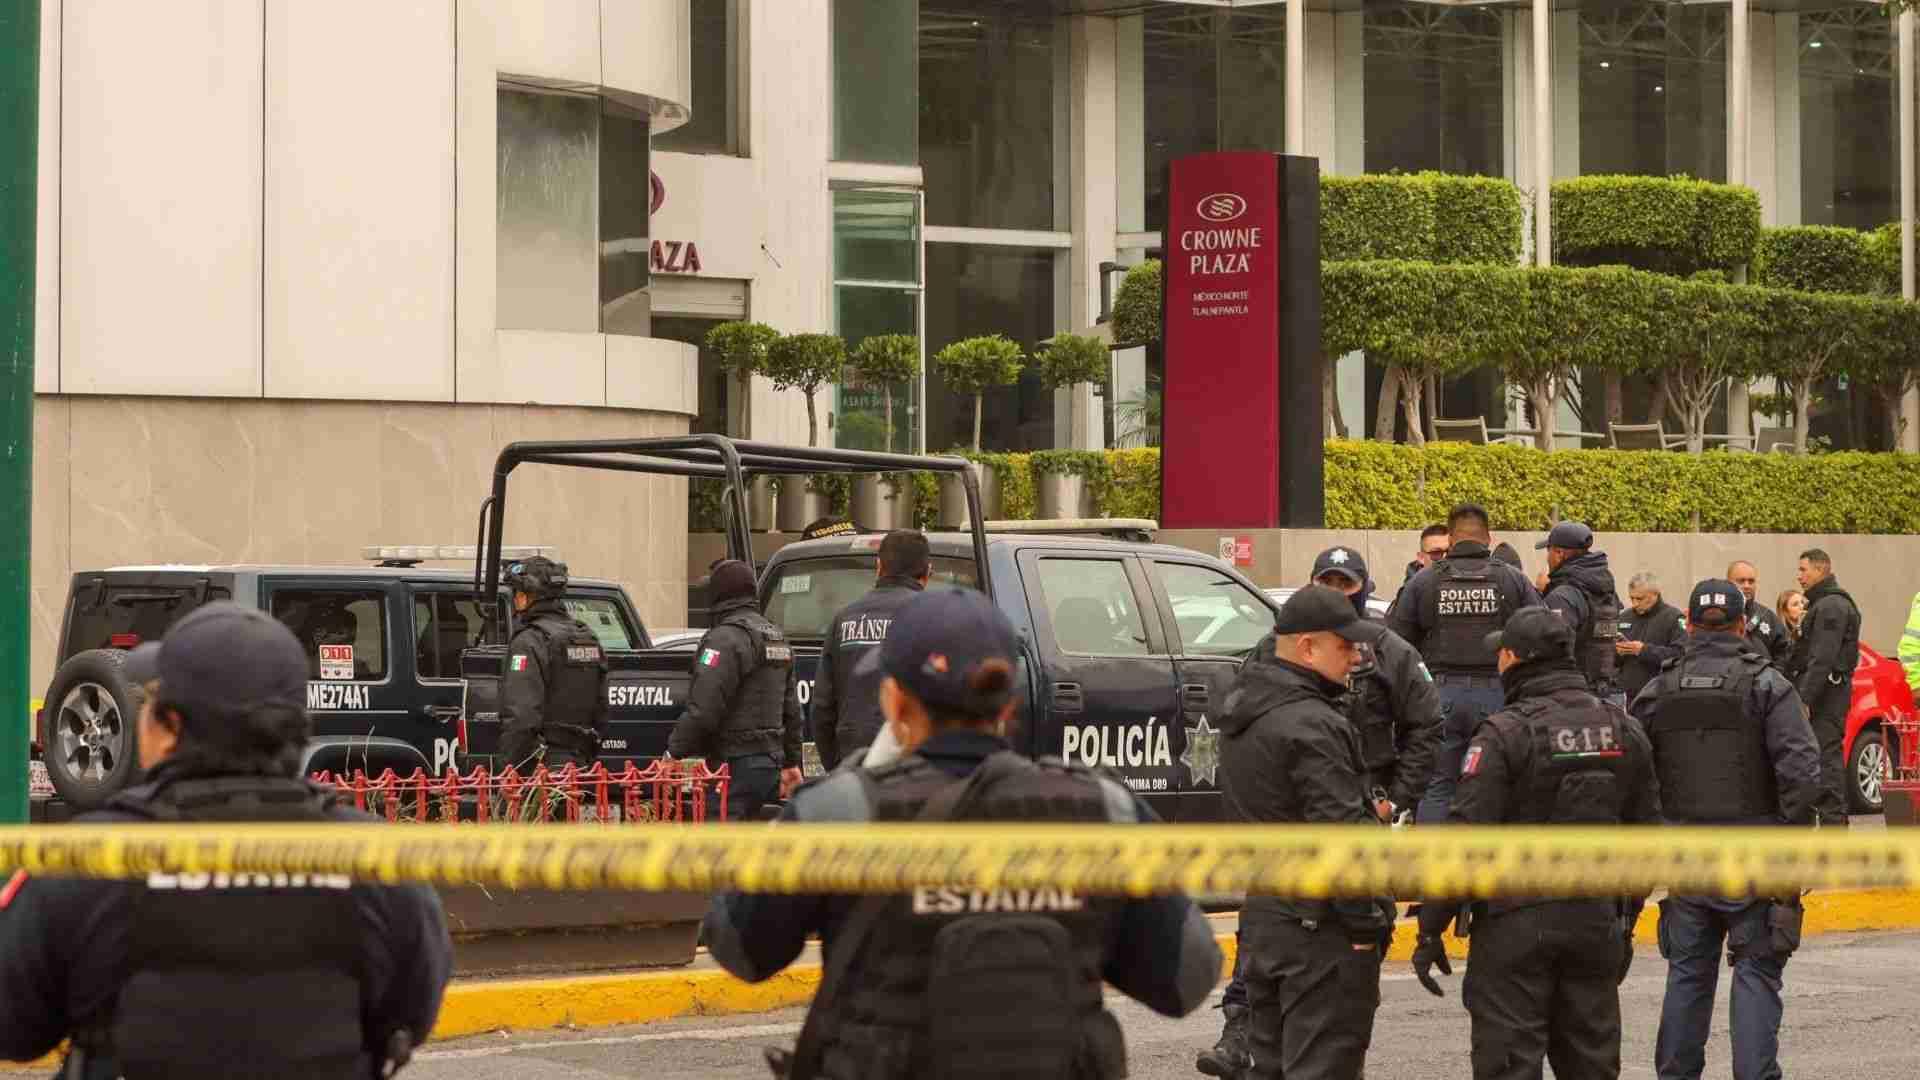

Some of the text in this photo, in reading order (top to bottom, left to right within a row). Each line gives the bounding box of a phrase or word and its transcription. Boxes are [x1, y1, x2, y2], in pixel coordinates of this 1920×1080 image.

[1180, 227, 1262, 251] CROWNE
[1190, 253, 1250, 275] PLAZA
[1439, 588, 1497, 602] POLICIA
[1438, 601, 1499, 616] ESTATAL
[841, 613, 893, 642] TRÁNSI
[322, 648, 351, 659] 911
[306, 684, 369, 709] ME274A1
[608, 686, 673, 706] ESTATAL
[1063, 716, 1173, 767] POLICÍA
[1557, 727, 1619, 751] G.I.F.
